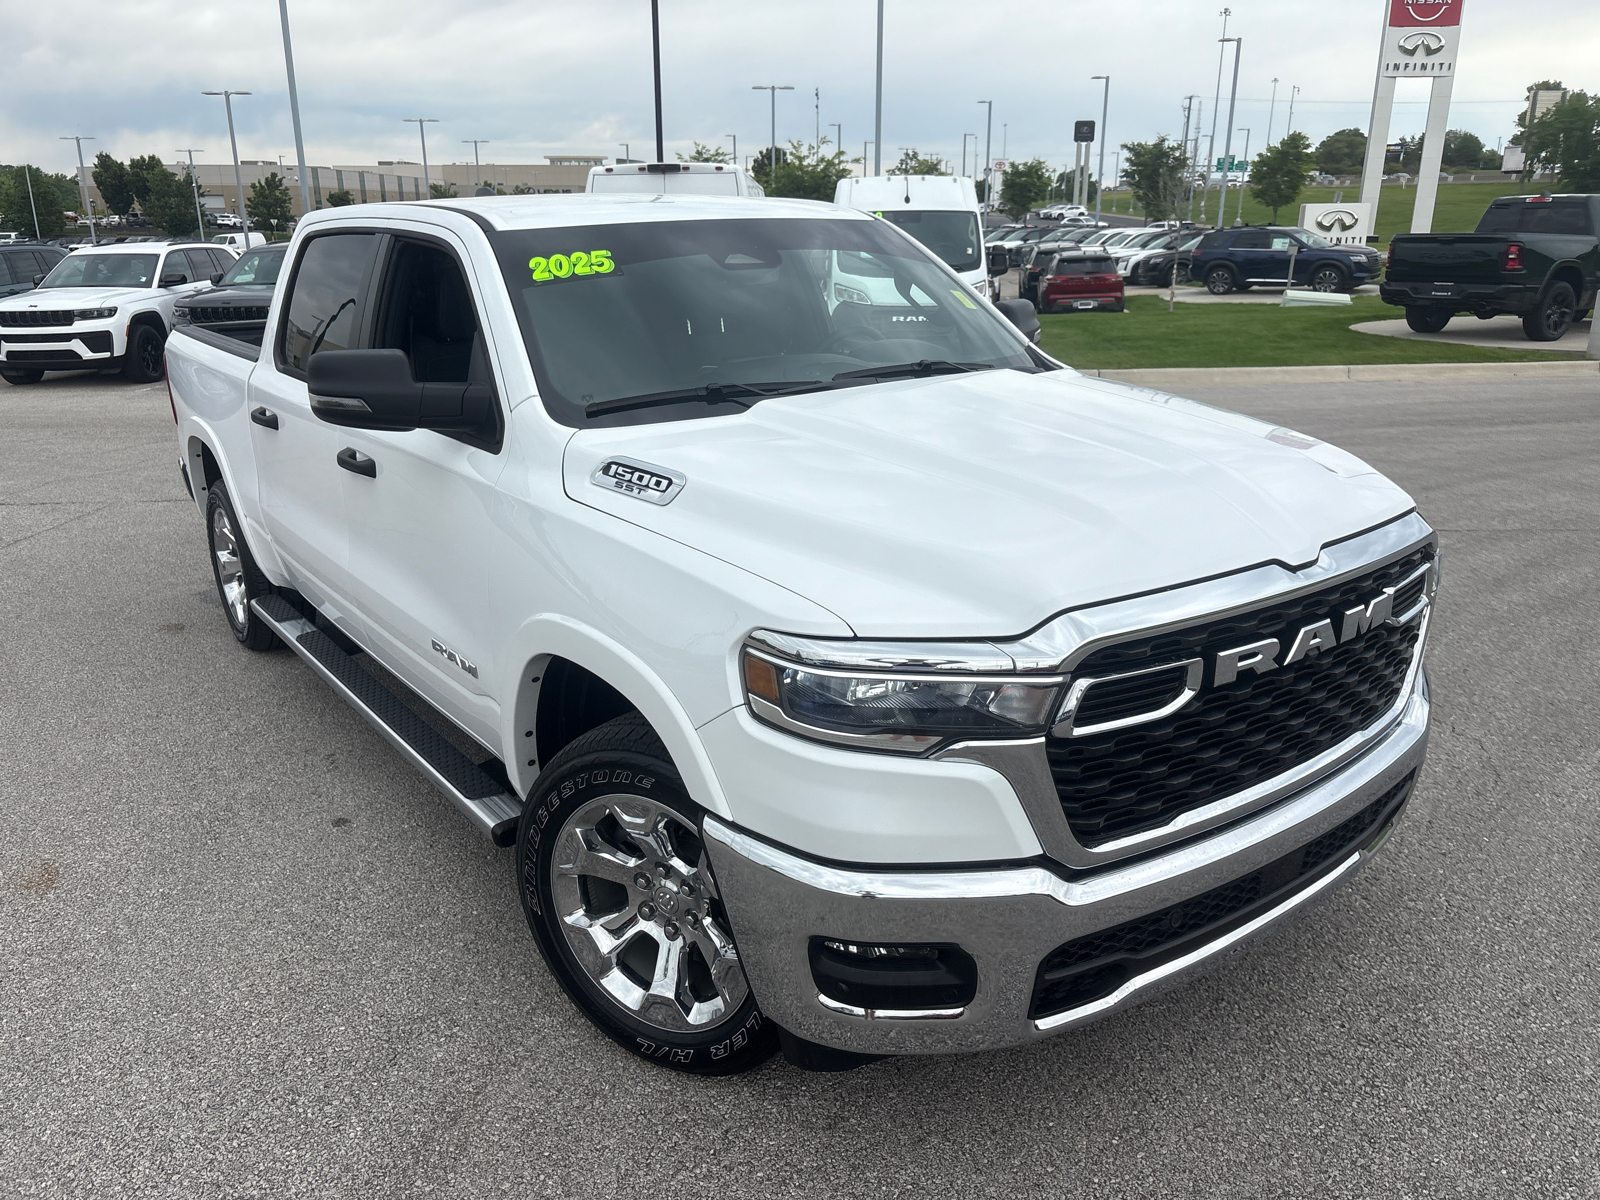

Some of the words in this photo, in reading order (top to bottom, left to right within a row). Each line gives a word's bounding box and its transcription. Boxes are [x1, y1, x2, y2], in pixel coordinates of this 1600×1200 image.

[1385, 62, 1452, 72] INFINITI
[528, 249, 615, 282] 2025
[608, 463, 670, 492] 1500
[613, 480, 648, 495] SST
[1213, 588, 1394, 688] RAM
[431, 636, 480, 680] RAM
[524, 769, 656, 916] BRIDGESTONE
[710, 1011, 766, 1060] LER
